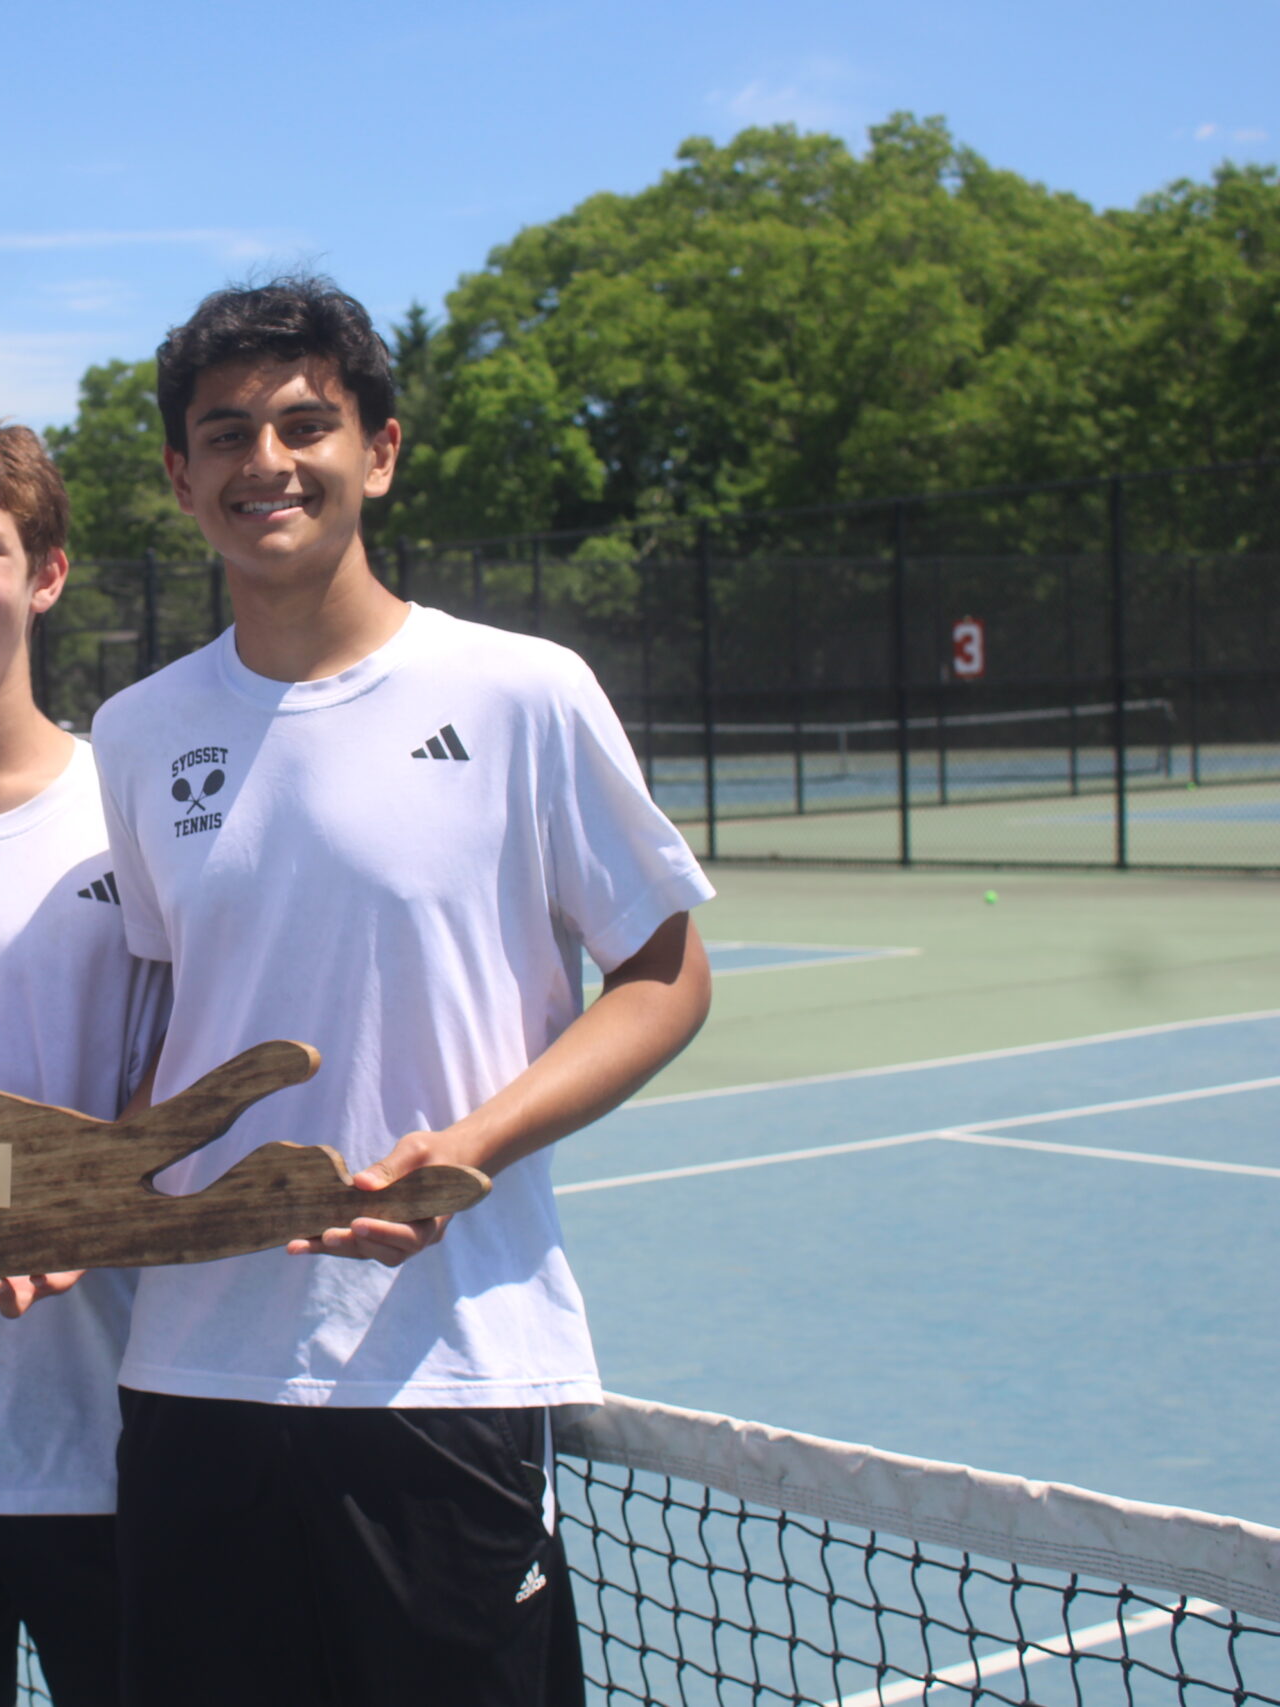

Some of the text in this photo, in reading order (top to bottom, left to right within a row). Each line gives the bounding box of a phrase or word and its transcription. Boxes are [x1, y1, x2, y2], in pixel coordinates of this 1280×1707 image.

[953, 624, 983, 674] 3
[170, 746, 228, 778] SYOSSET
[174, 812, 222, 838] TENNIS
